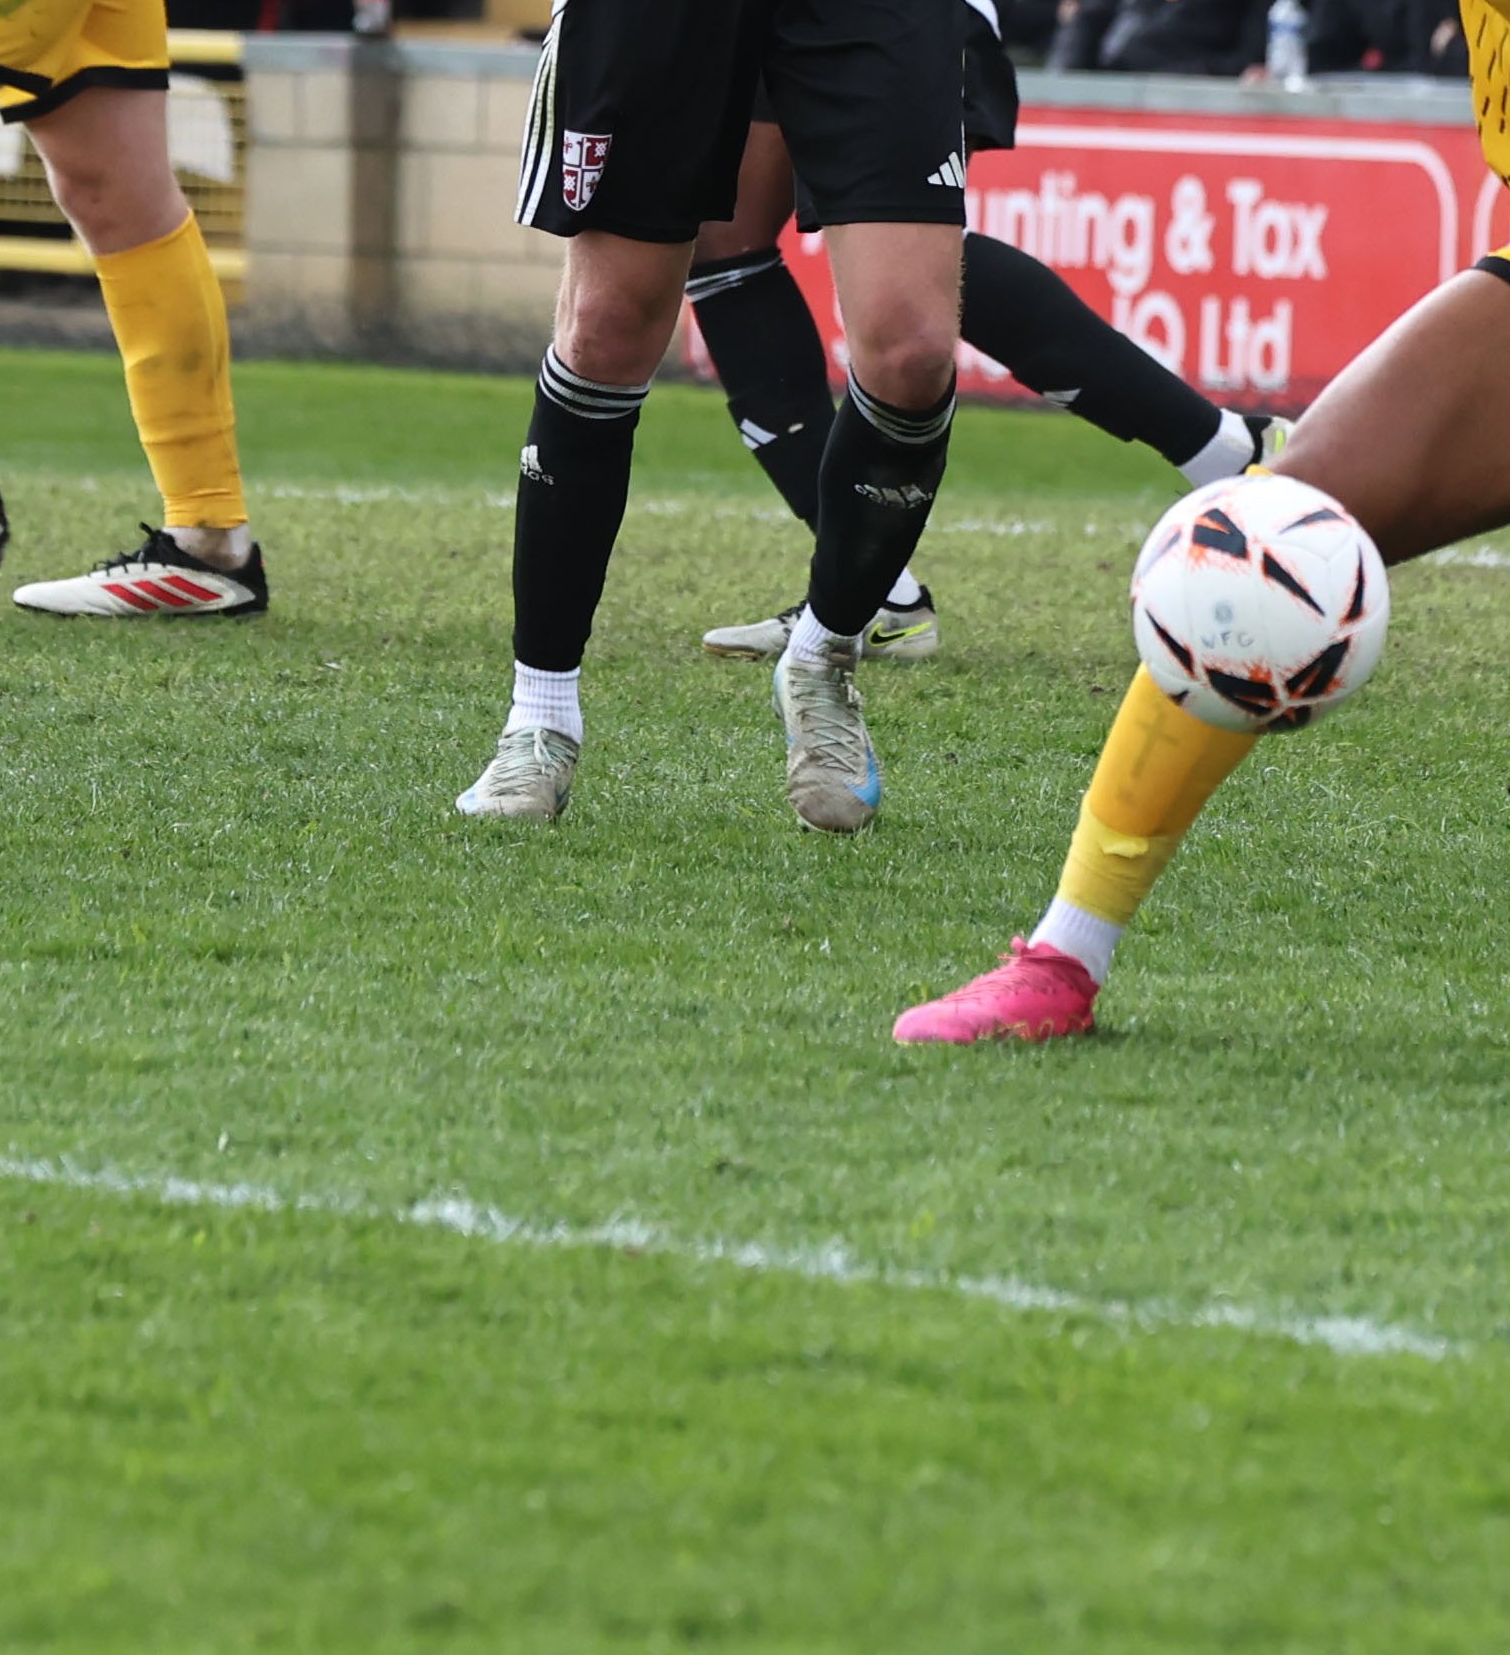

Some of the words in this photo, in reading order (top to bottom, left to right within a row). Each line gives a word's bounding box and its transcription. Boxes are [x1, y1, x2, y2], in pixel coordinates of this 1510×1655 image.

[965, 170, 1157, 297] unting
[1164, 173, 1216, 276] &
[1225, 177, 1330, 281] Tax
[1198, 293, 1292, 393] Ltd
